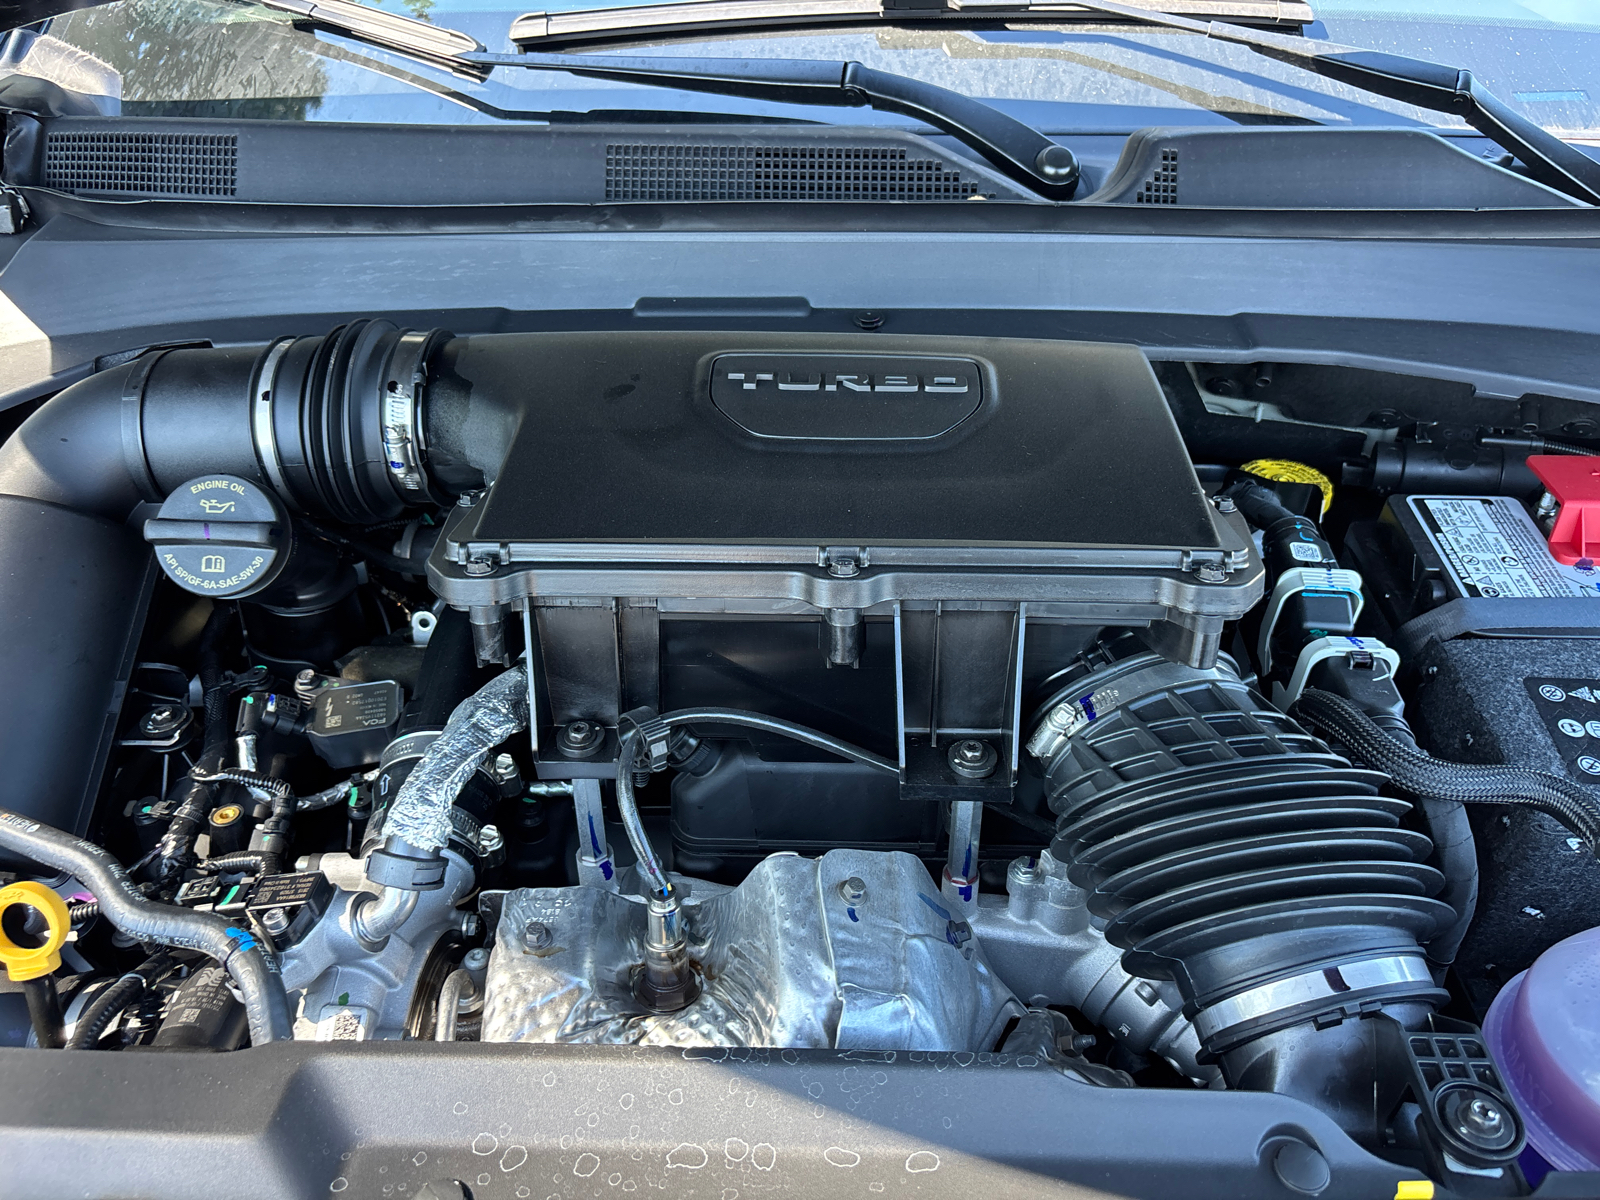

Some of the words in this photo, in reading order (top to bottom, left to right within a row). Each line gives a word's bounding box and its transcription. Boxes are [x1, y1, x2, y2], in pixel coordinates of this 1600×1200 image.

[727, 371, 969, 394] TURBO
[190, 480, 229, 494] ENGINE
[230, 482, 246, 496] OIL
[164, 553, 179, 569] API
[362, 717, 387, 726] FCA
